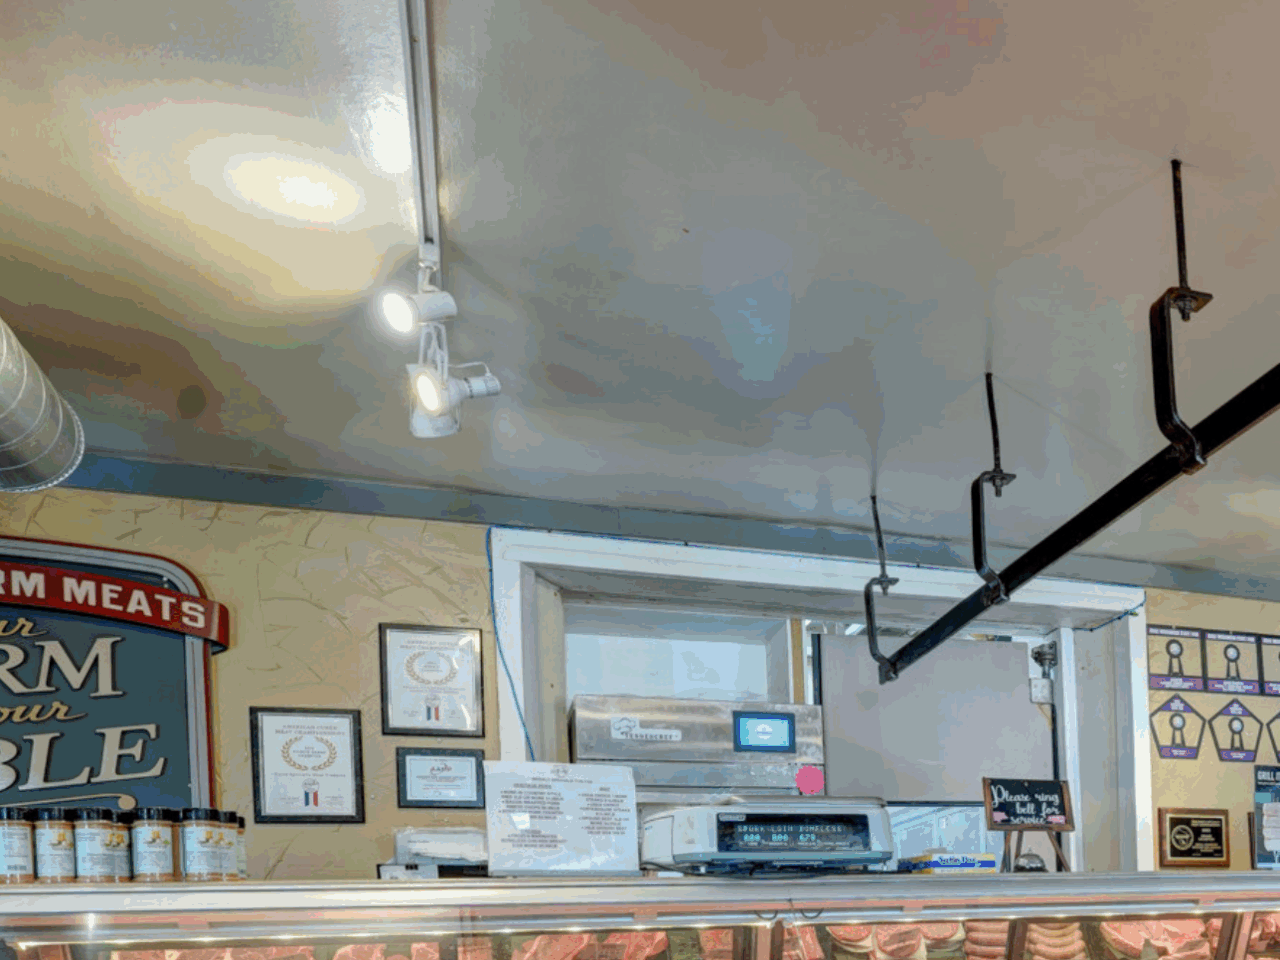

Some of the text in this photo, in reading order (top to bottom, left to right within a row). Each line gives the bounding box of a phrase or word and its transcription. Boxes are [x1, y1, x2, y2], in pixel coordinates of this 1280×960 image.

[62, 576, 206, 629] MEATS
[991, 784, 1060, 808] Please ring
[1009, 815, 1046, 825] service
[1015, 802, 1060, 819] bell for
